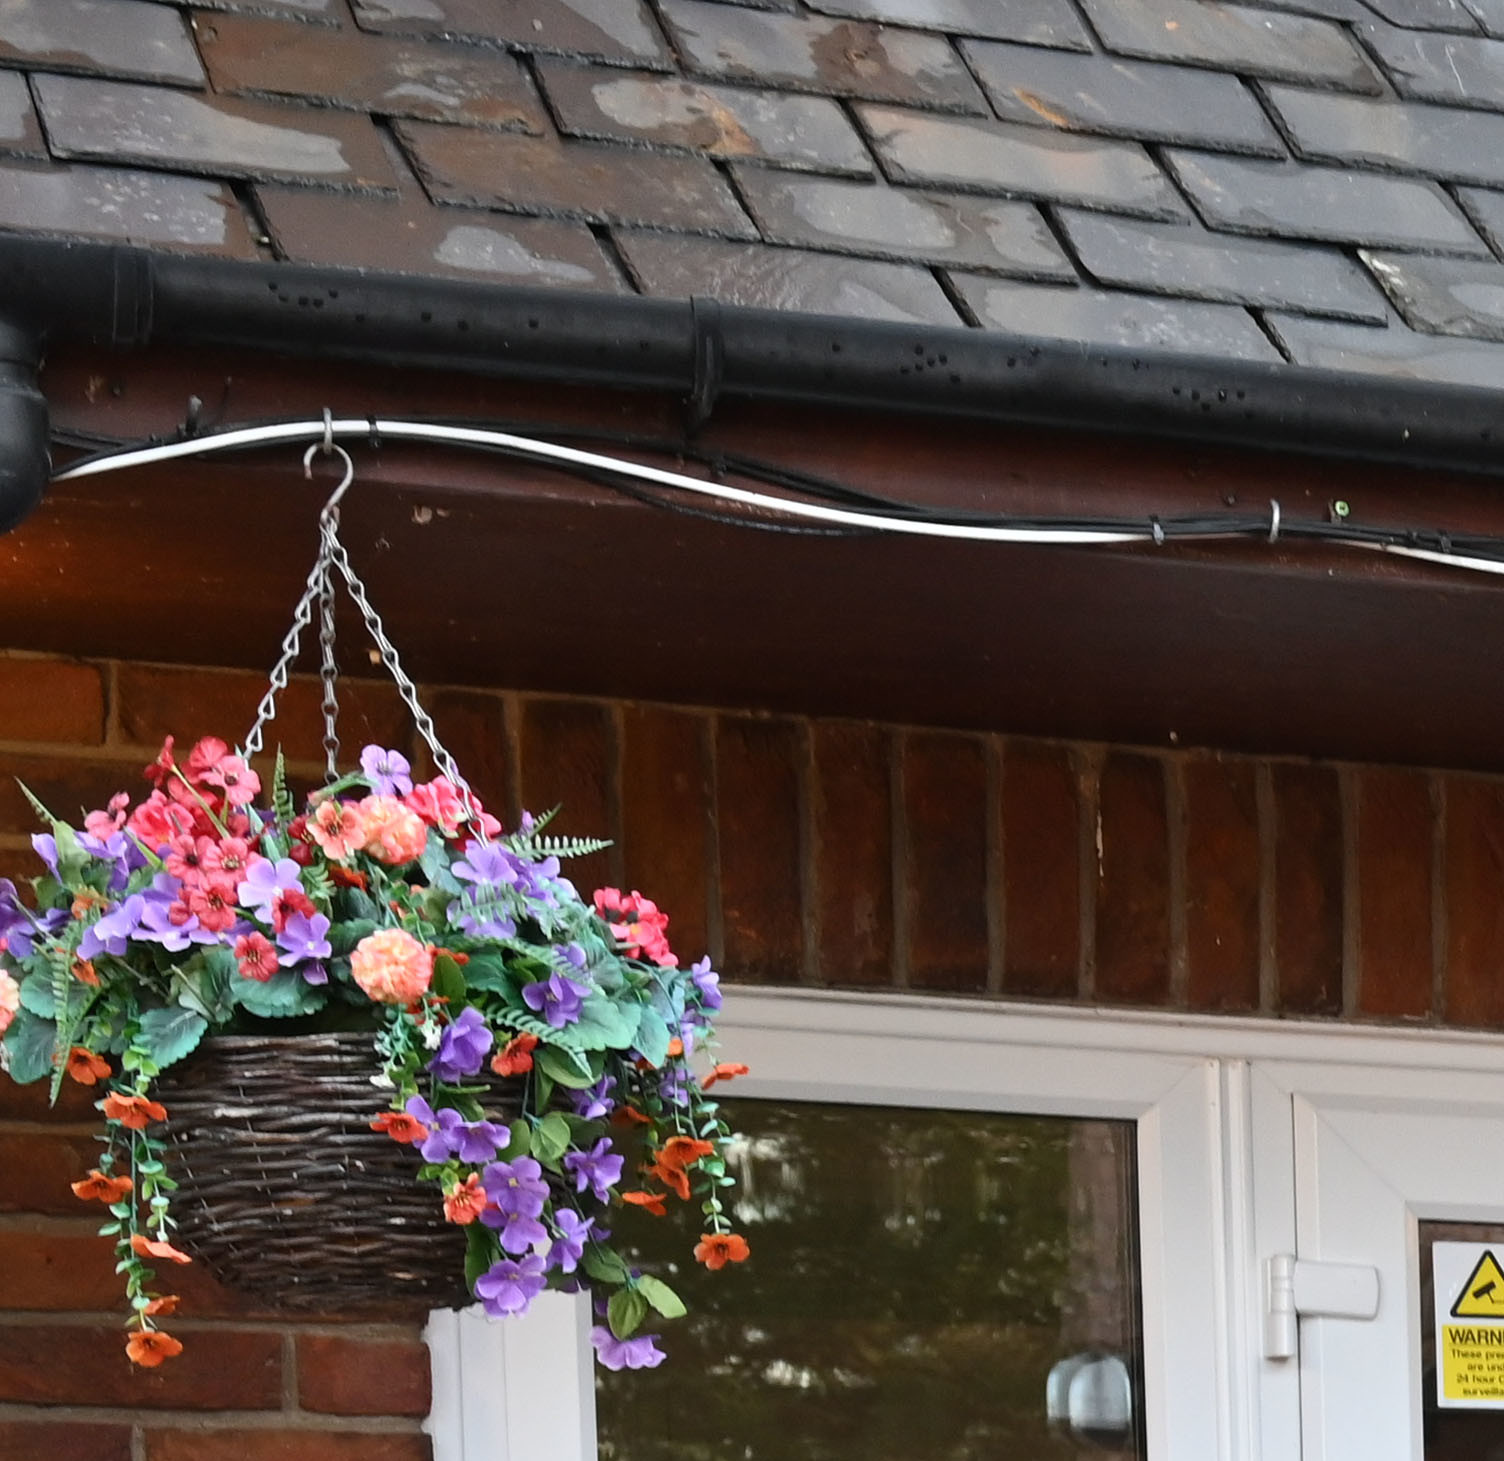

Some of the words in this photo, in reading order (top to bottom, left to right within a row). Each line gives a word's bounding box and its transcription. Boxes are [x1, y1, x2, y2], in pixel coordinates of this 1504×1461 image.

[1451, 1349, 1482, 1360] These
[1466, 1363, 1484, 1371] are
[1456, 1374, 1469, 1384] 24
[1472, 1374, 1496, 1384] hour
